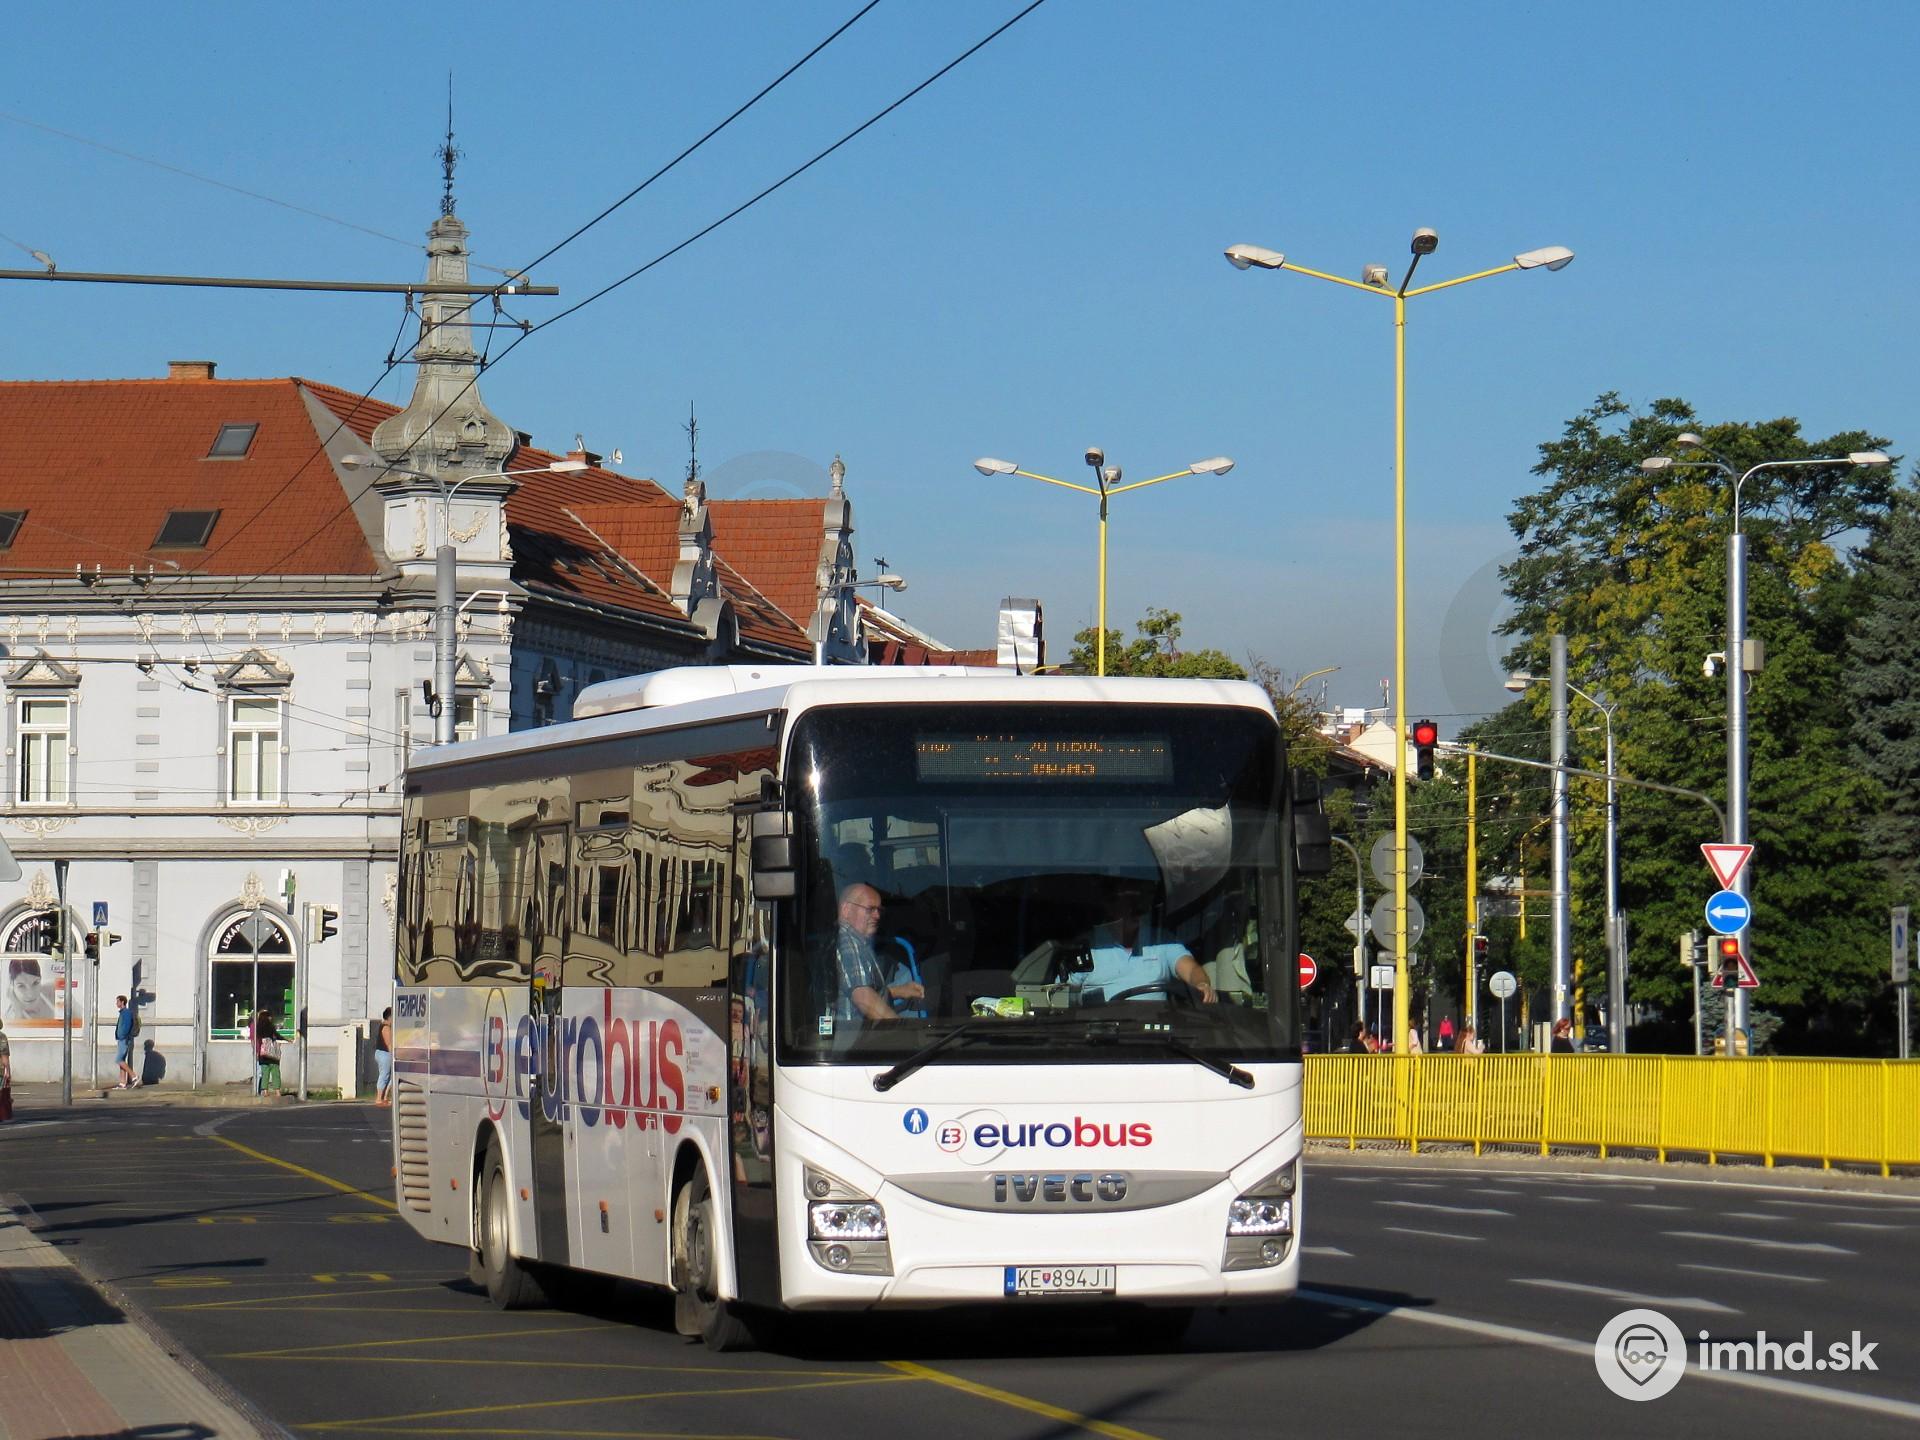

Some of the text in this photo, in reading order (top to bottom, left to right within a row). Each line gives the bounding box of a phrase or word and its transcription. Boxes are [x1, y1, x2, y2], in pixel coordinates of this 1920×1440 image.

[8, 918, 40, 949] LEKÁREŇ
[397, 993, 427, 1018] TEMPUS
[514, 988, 685, 1135] eurobus
[973, 1116, 1153, 1148] eurobus
[994, 1173, 1129, 1203] IVECO
